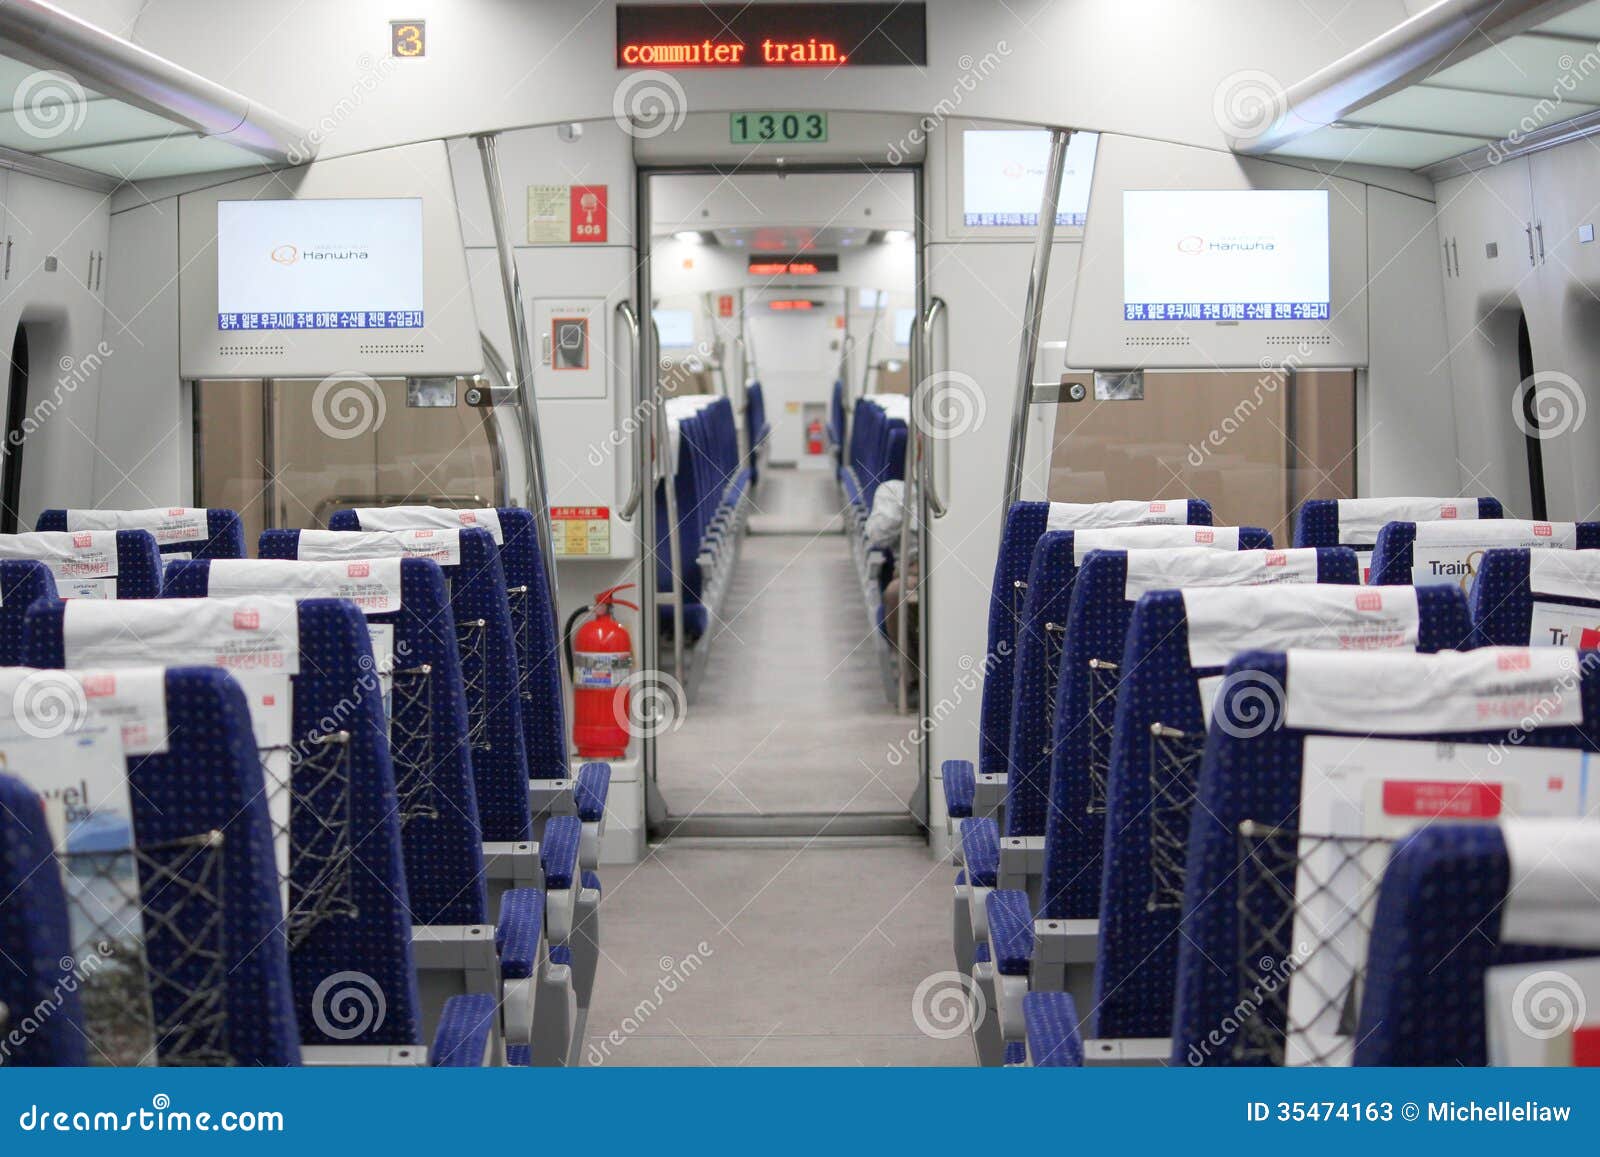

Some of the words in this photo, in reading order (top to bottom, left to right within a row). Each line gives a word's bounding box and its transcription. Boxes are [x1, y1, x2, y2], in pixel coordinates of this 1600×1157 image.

[397, 25, 422, 56] 3
[623, 40, 744, 63] commuter
[762, 39, 849, 63] train.
[735, 114, 823, 140] 1303
[576, 224, 601, 235] SOS
[1209, 241, 1275, 251] Hanwha
[303, 250, 369, 260] Hanwha
[1428, 560, 1472, 575] Train
